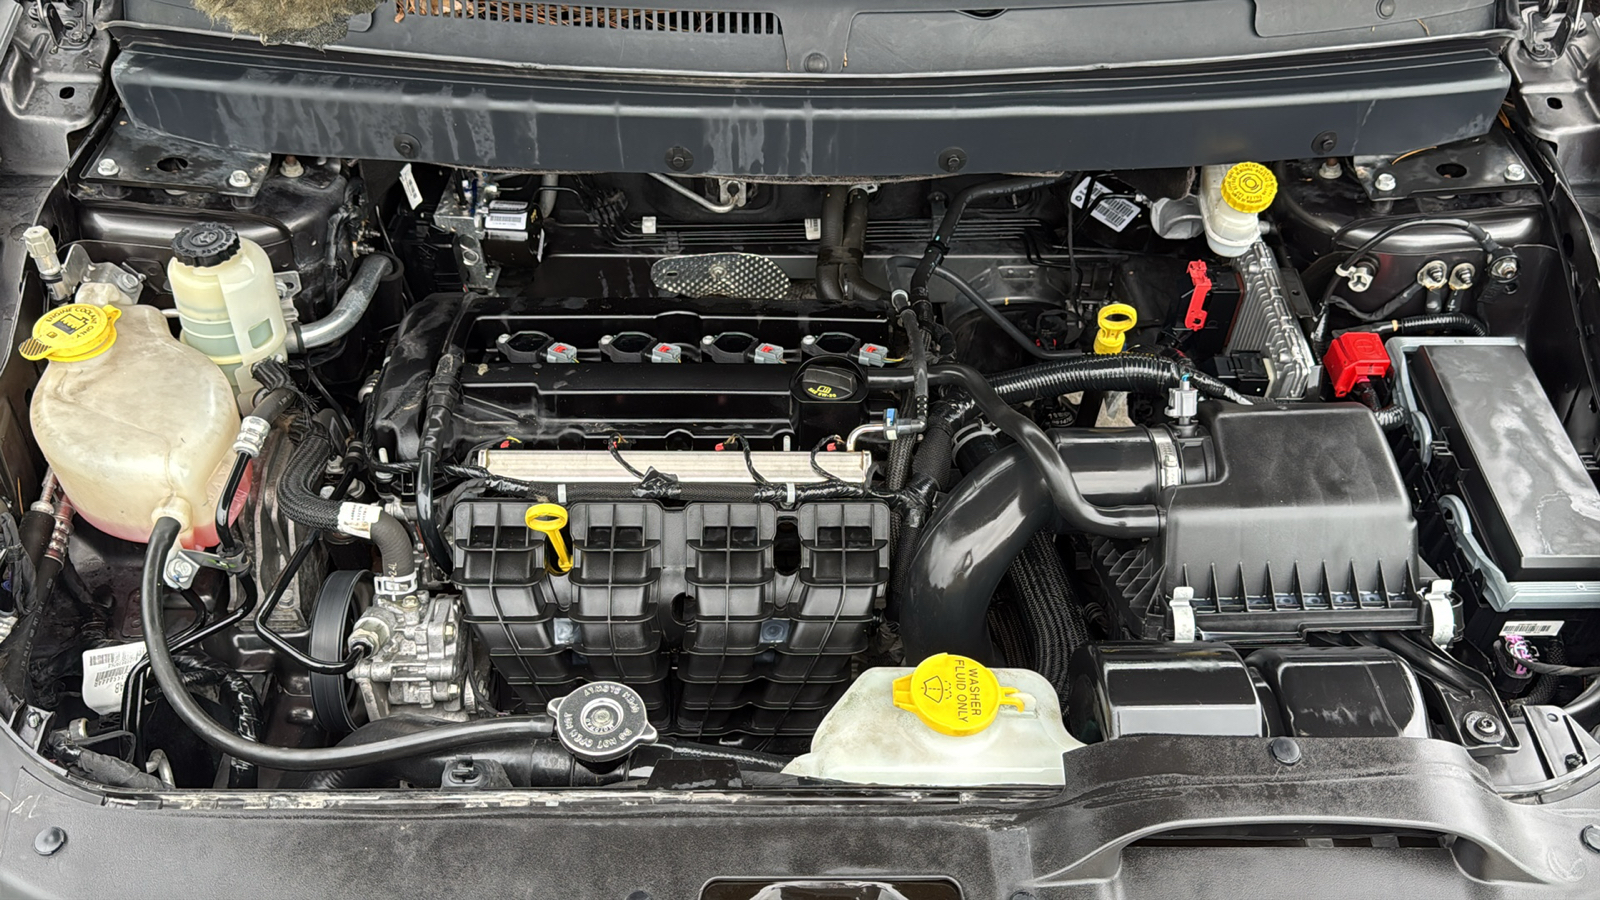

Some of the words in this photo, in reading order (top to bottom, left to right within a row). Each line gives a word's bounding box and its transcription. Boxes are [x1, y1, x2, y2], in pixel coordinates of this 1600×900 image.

[46, 307, 73, 322] ENGINE
[74, 307, 98, 325] COOLANT
[76, 325, 95, 339] ONLY
[954, 659, 967, 691] FLUID
[583, 685, 621, 698] SLOWLY
[968, 667, 982, 716] WASHER
[622, 691, 640, 713] OPEN
[956, 694, 969, 723] ONLY
[563, 712, 574, 730] HOT
[569, 729, 594, 748] OPEN
[597, 737, 618, 749] NOT
[618, 728, 633, 741] DO
